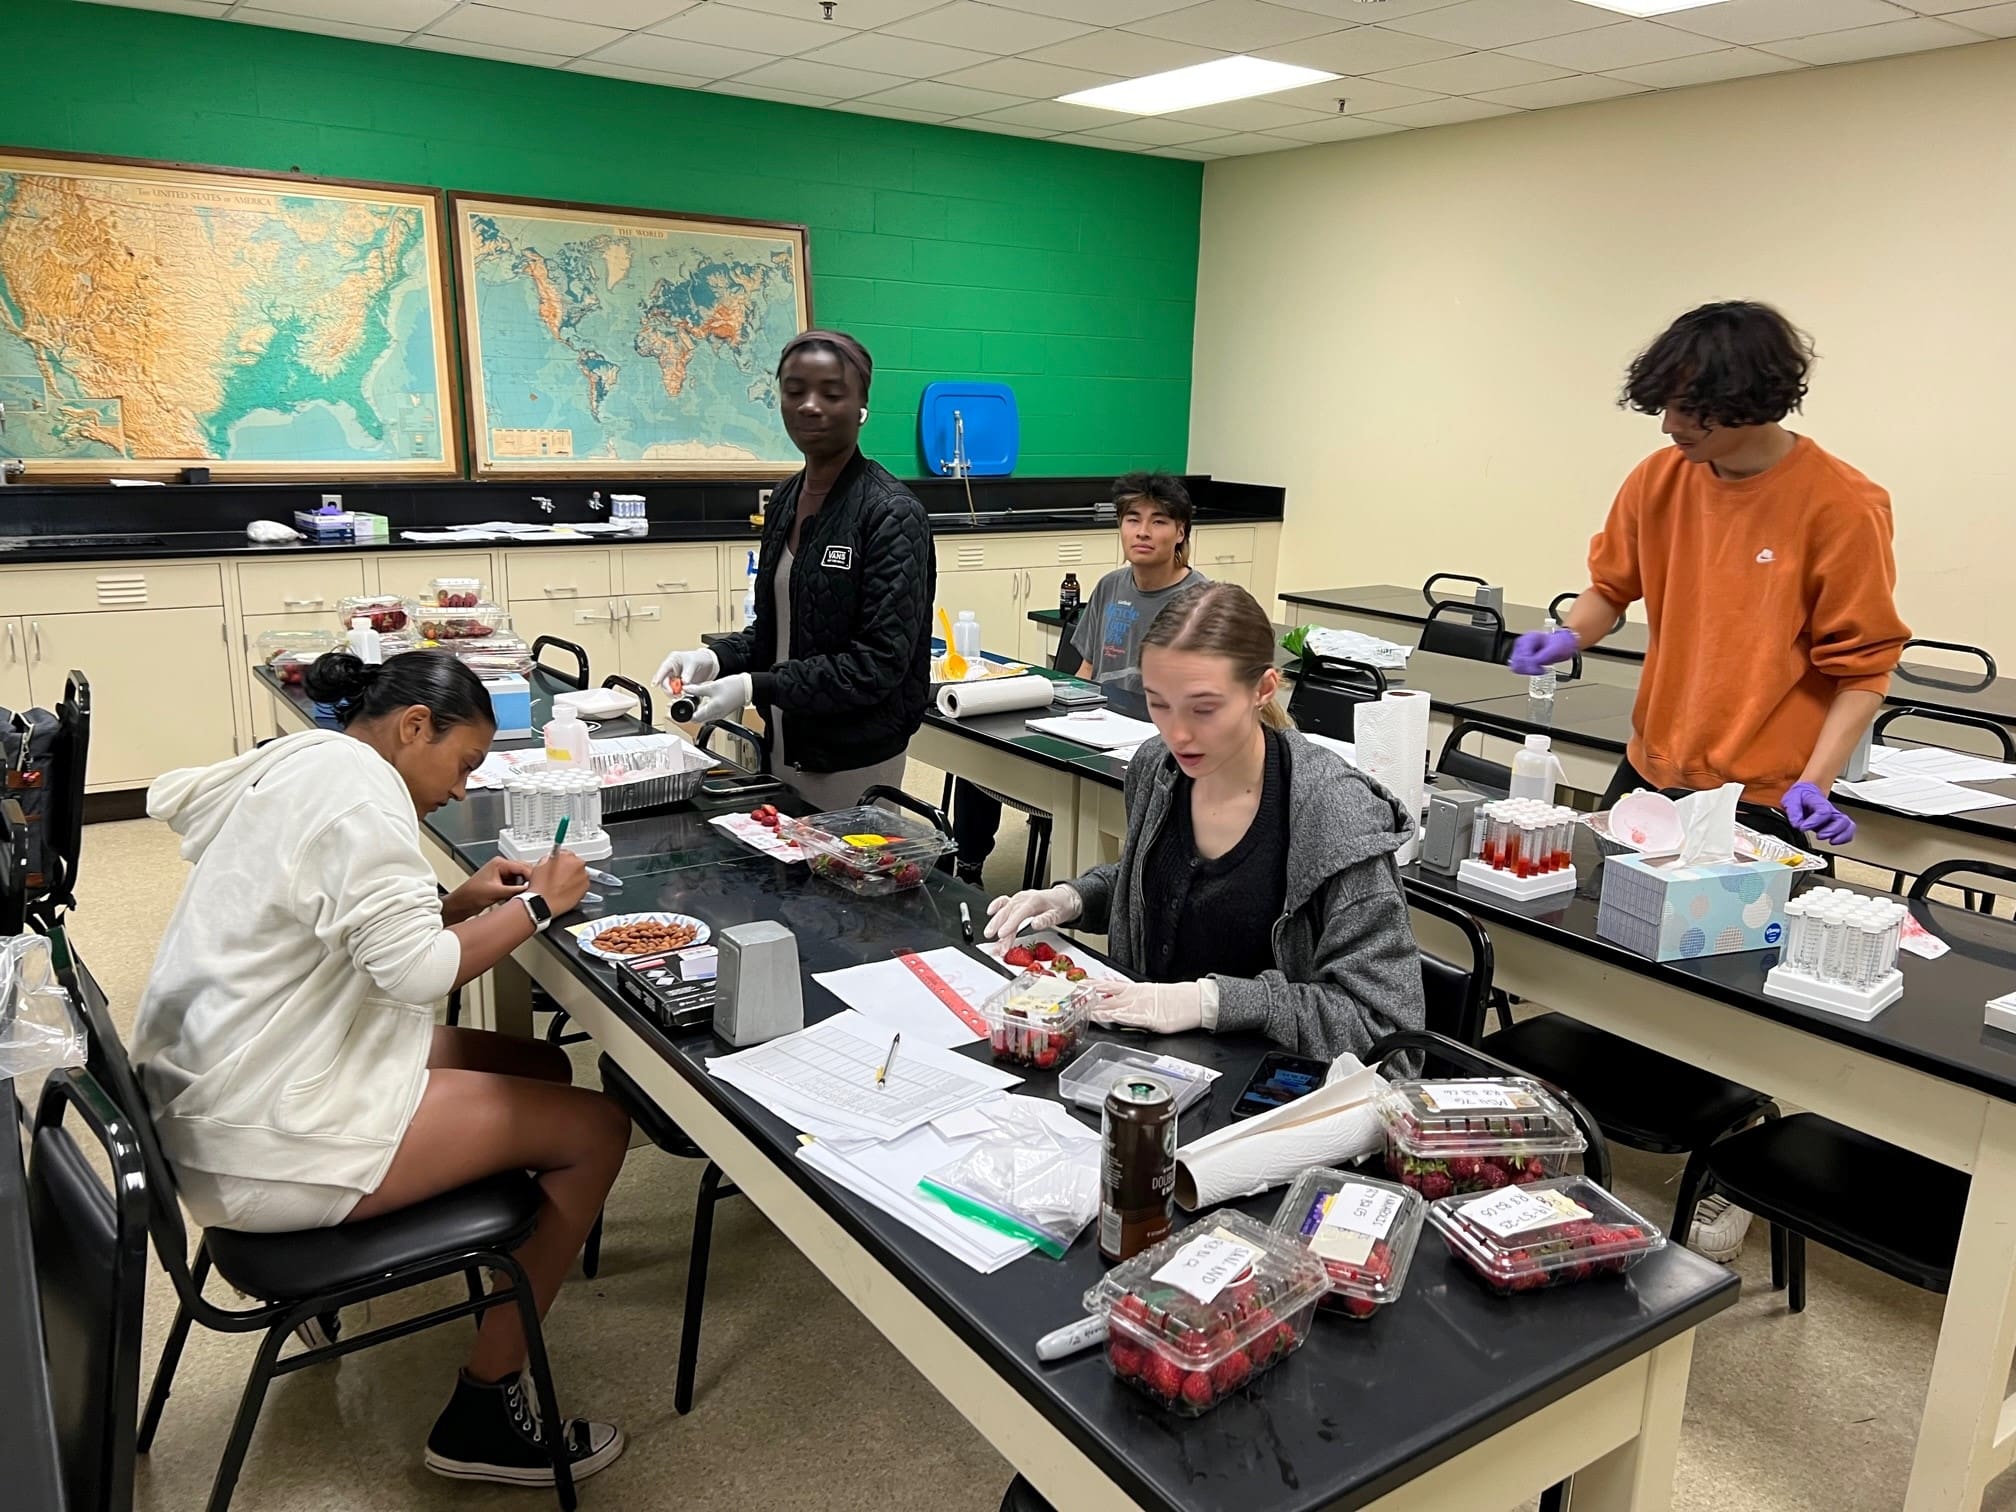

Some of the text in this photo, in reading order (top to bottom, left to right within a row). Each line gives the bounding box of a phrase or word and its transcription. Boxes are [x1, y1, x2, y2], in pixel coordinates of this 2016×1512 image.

[151, 188, 188, 199] UNITED
[191, 191, 221, 201] STATES
[234, 196, 272, 206] AMERICA
[618, 228, 664, 238] THE WORLD
[828, 550, 846, 560] VANS
